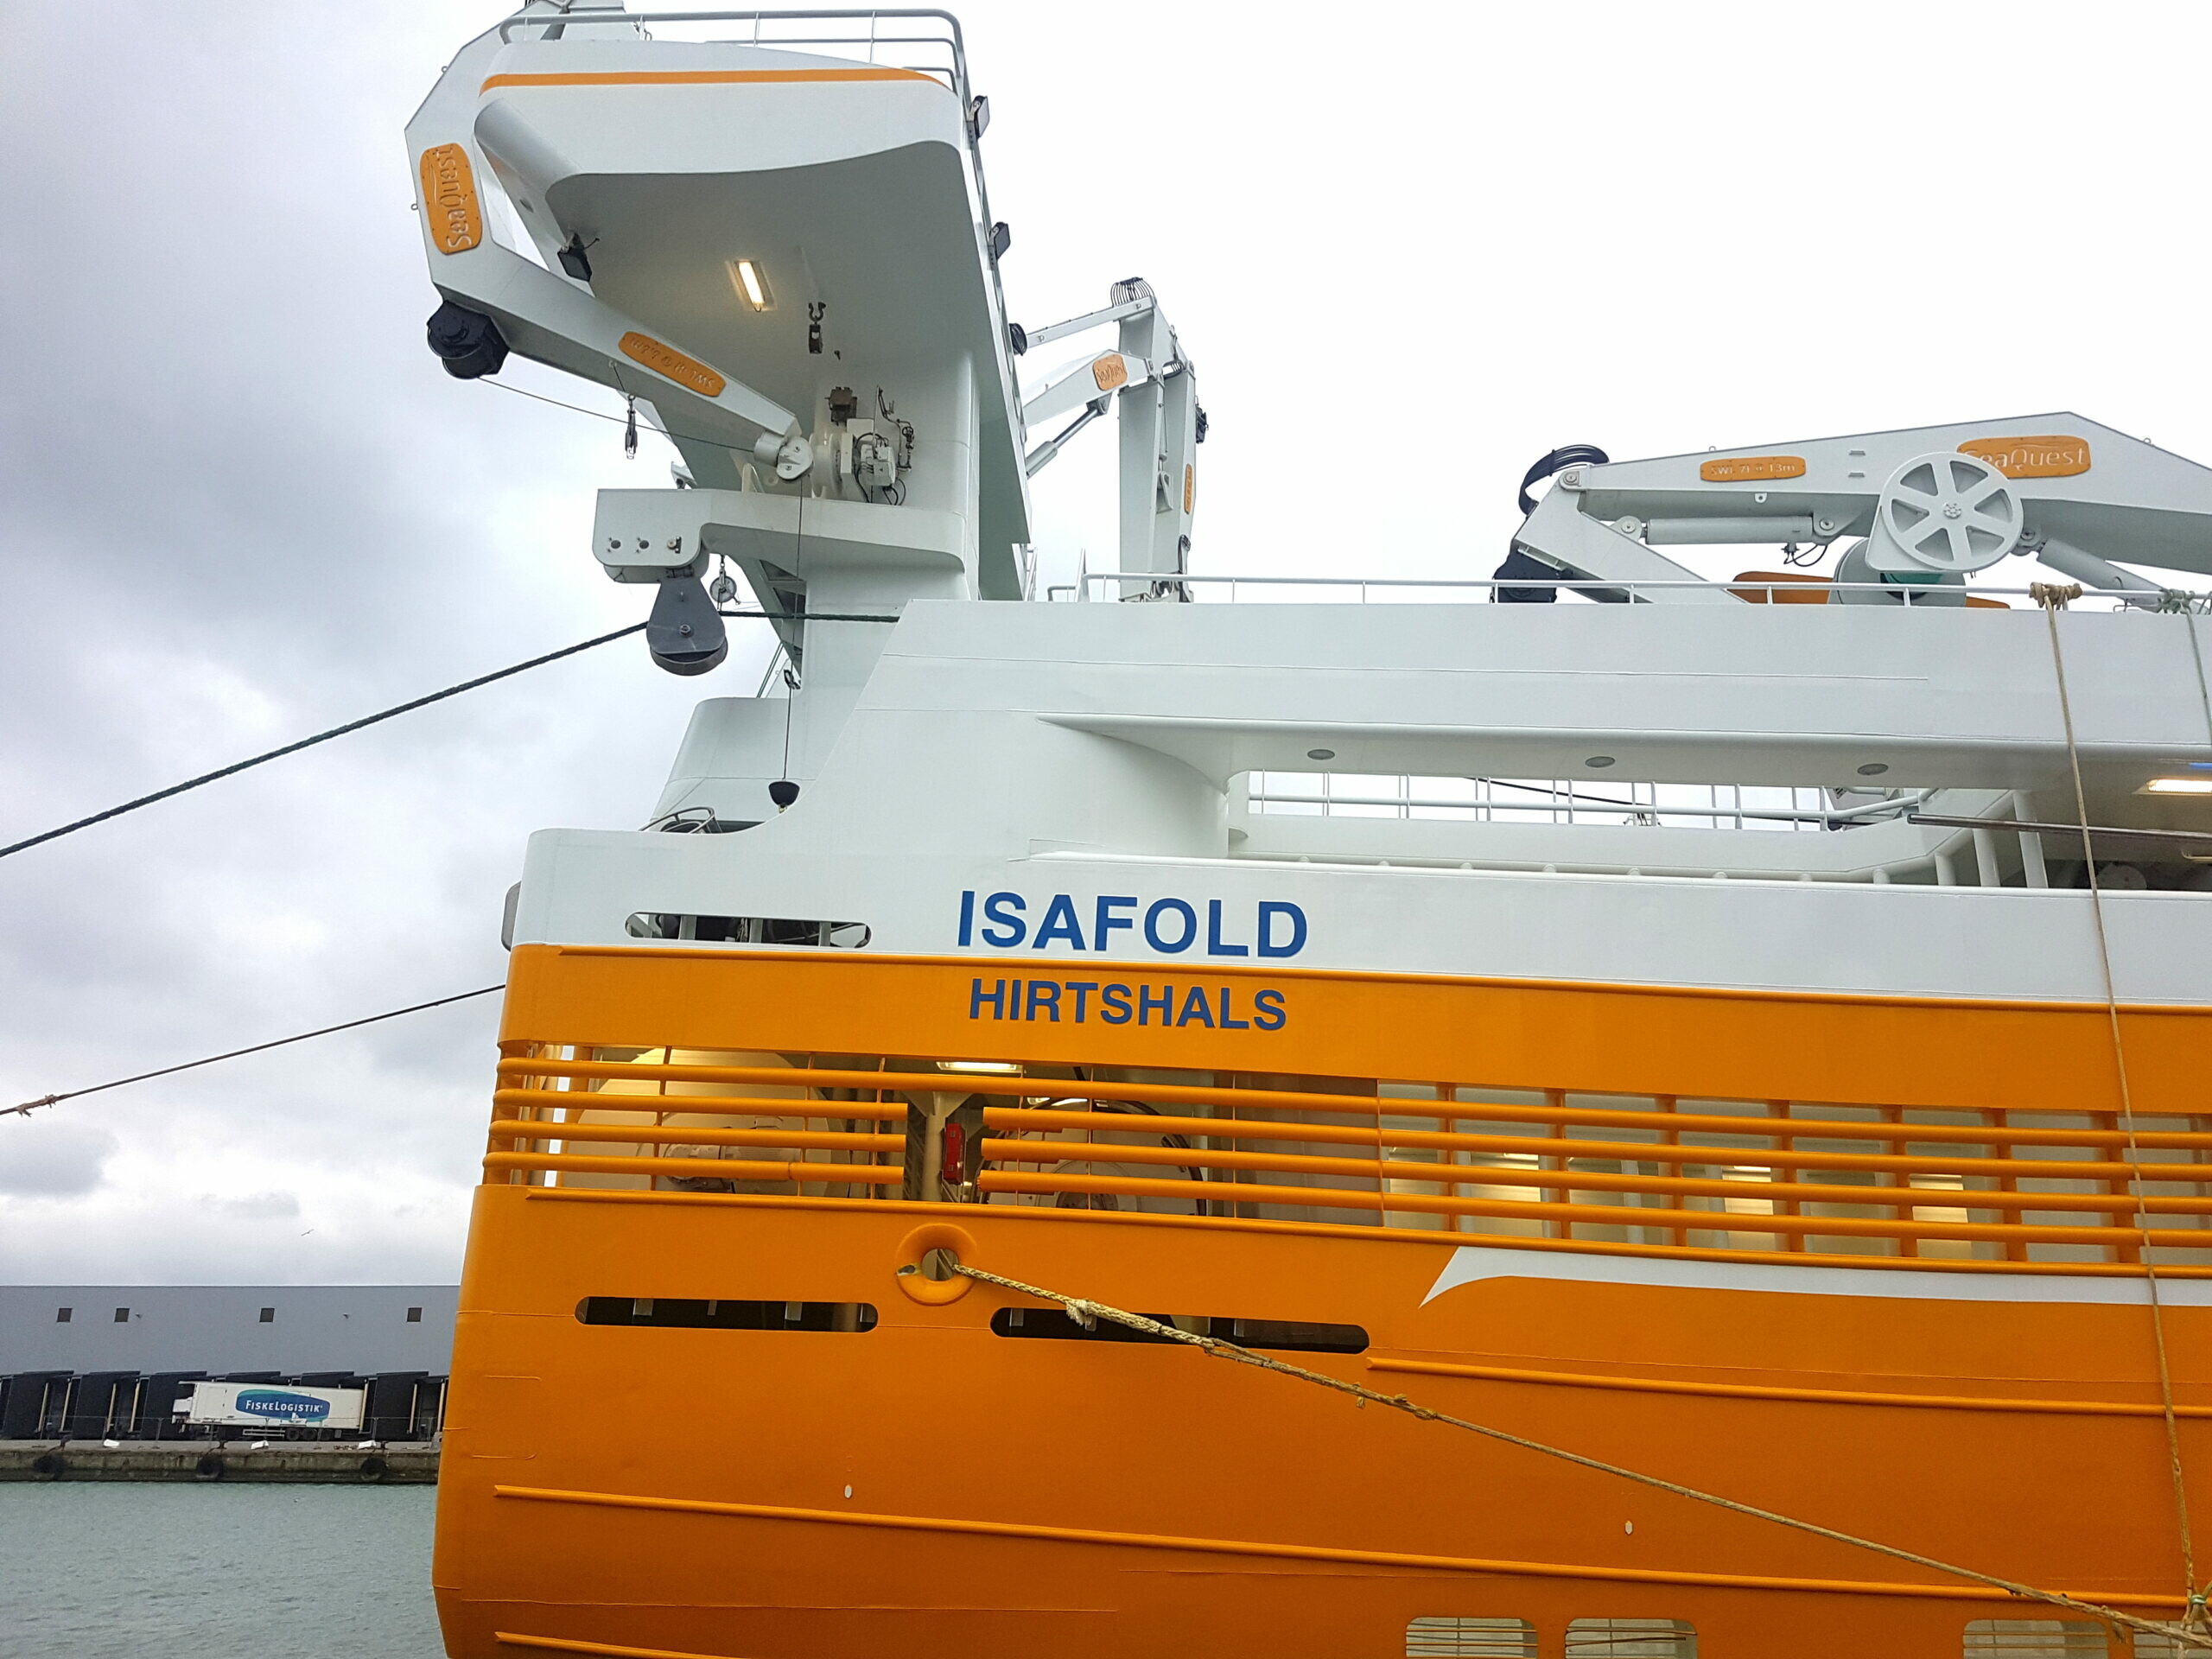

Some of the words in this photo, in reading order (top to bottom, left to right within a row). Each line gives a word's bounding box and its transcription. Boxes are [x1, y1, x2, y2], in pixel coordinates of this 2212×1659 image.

[434, 145, 472, 248] SeaQuest
[1768, 462, 1796, 474] 13m
[957, 890, 1307, 958] ISAFOLD
[969, 978, 1287, 1031] HIRTSHALS
